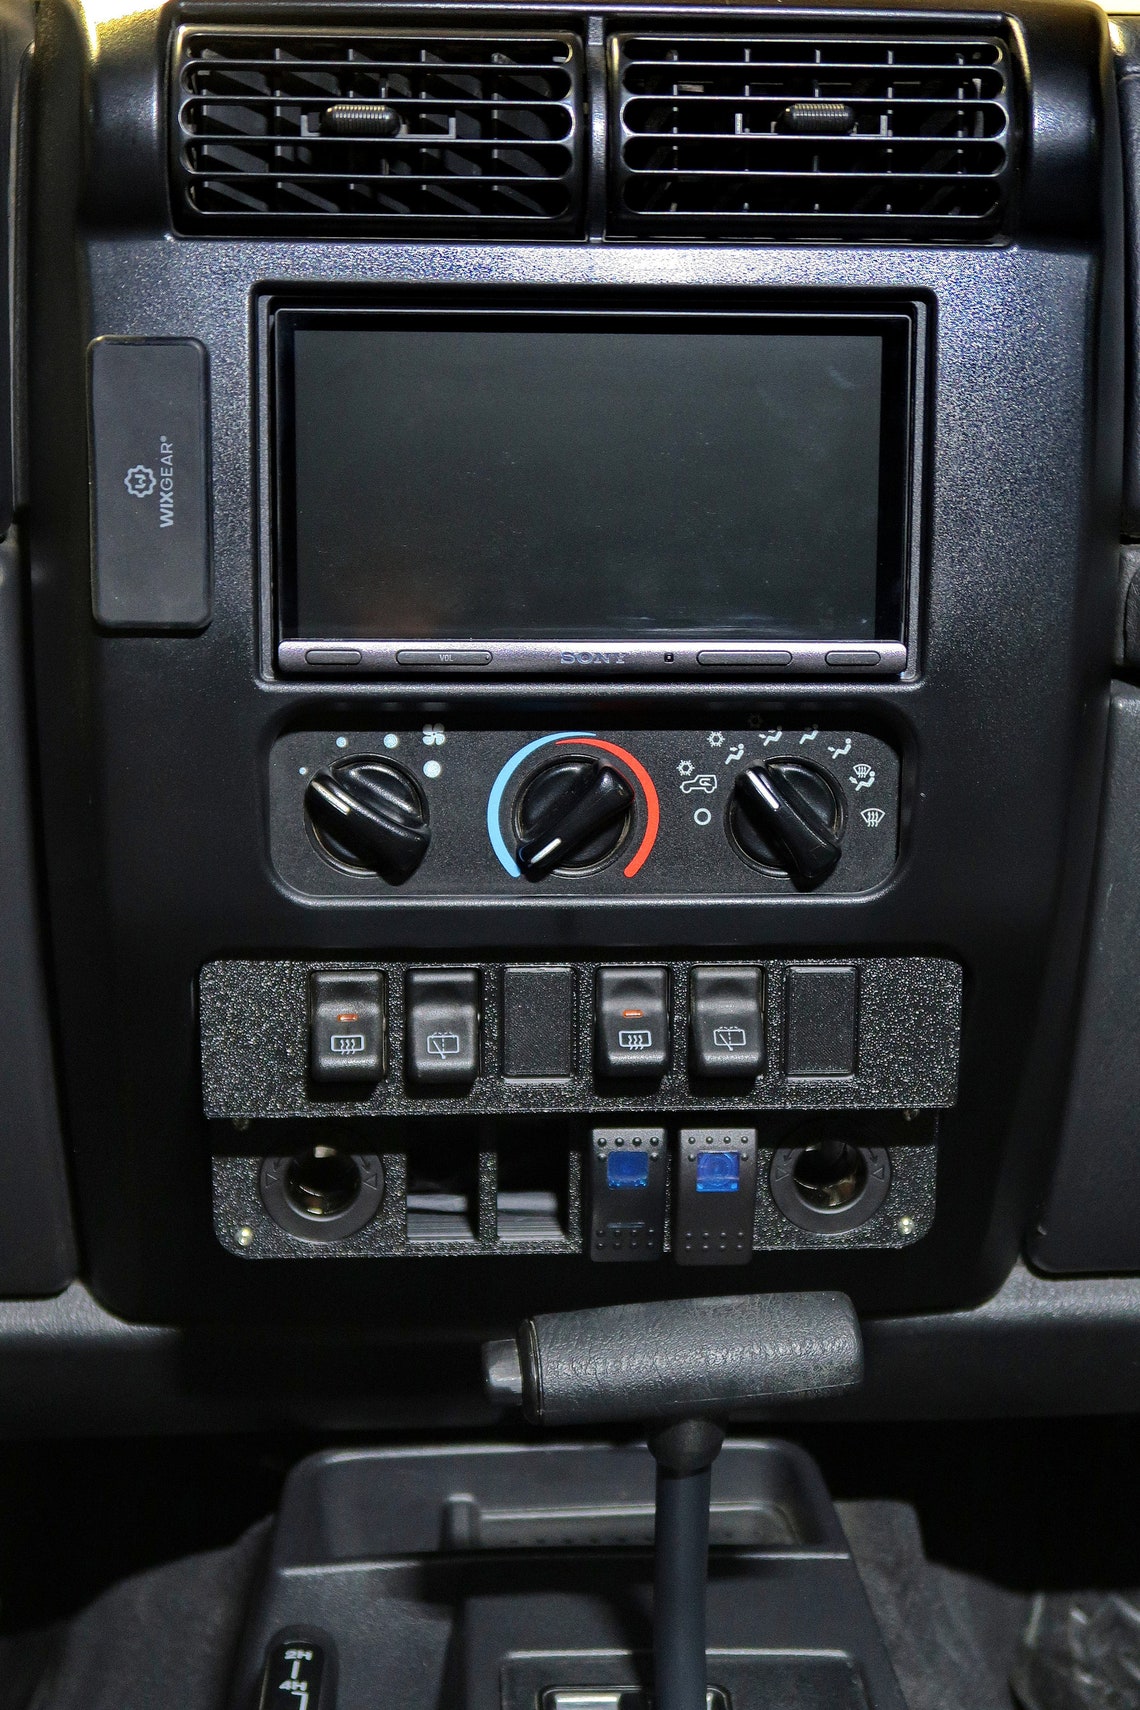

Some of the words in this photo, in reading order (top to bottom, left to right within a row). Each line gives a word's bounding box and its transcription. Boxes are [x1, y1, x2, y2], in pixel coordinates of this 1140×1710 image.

[439, 654, 454, 662] VOL
[560, 651, 629, 665] SONY
[284, 1649, 313, 1661] 2H
[279, 1680, 308, 1691] 4H
